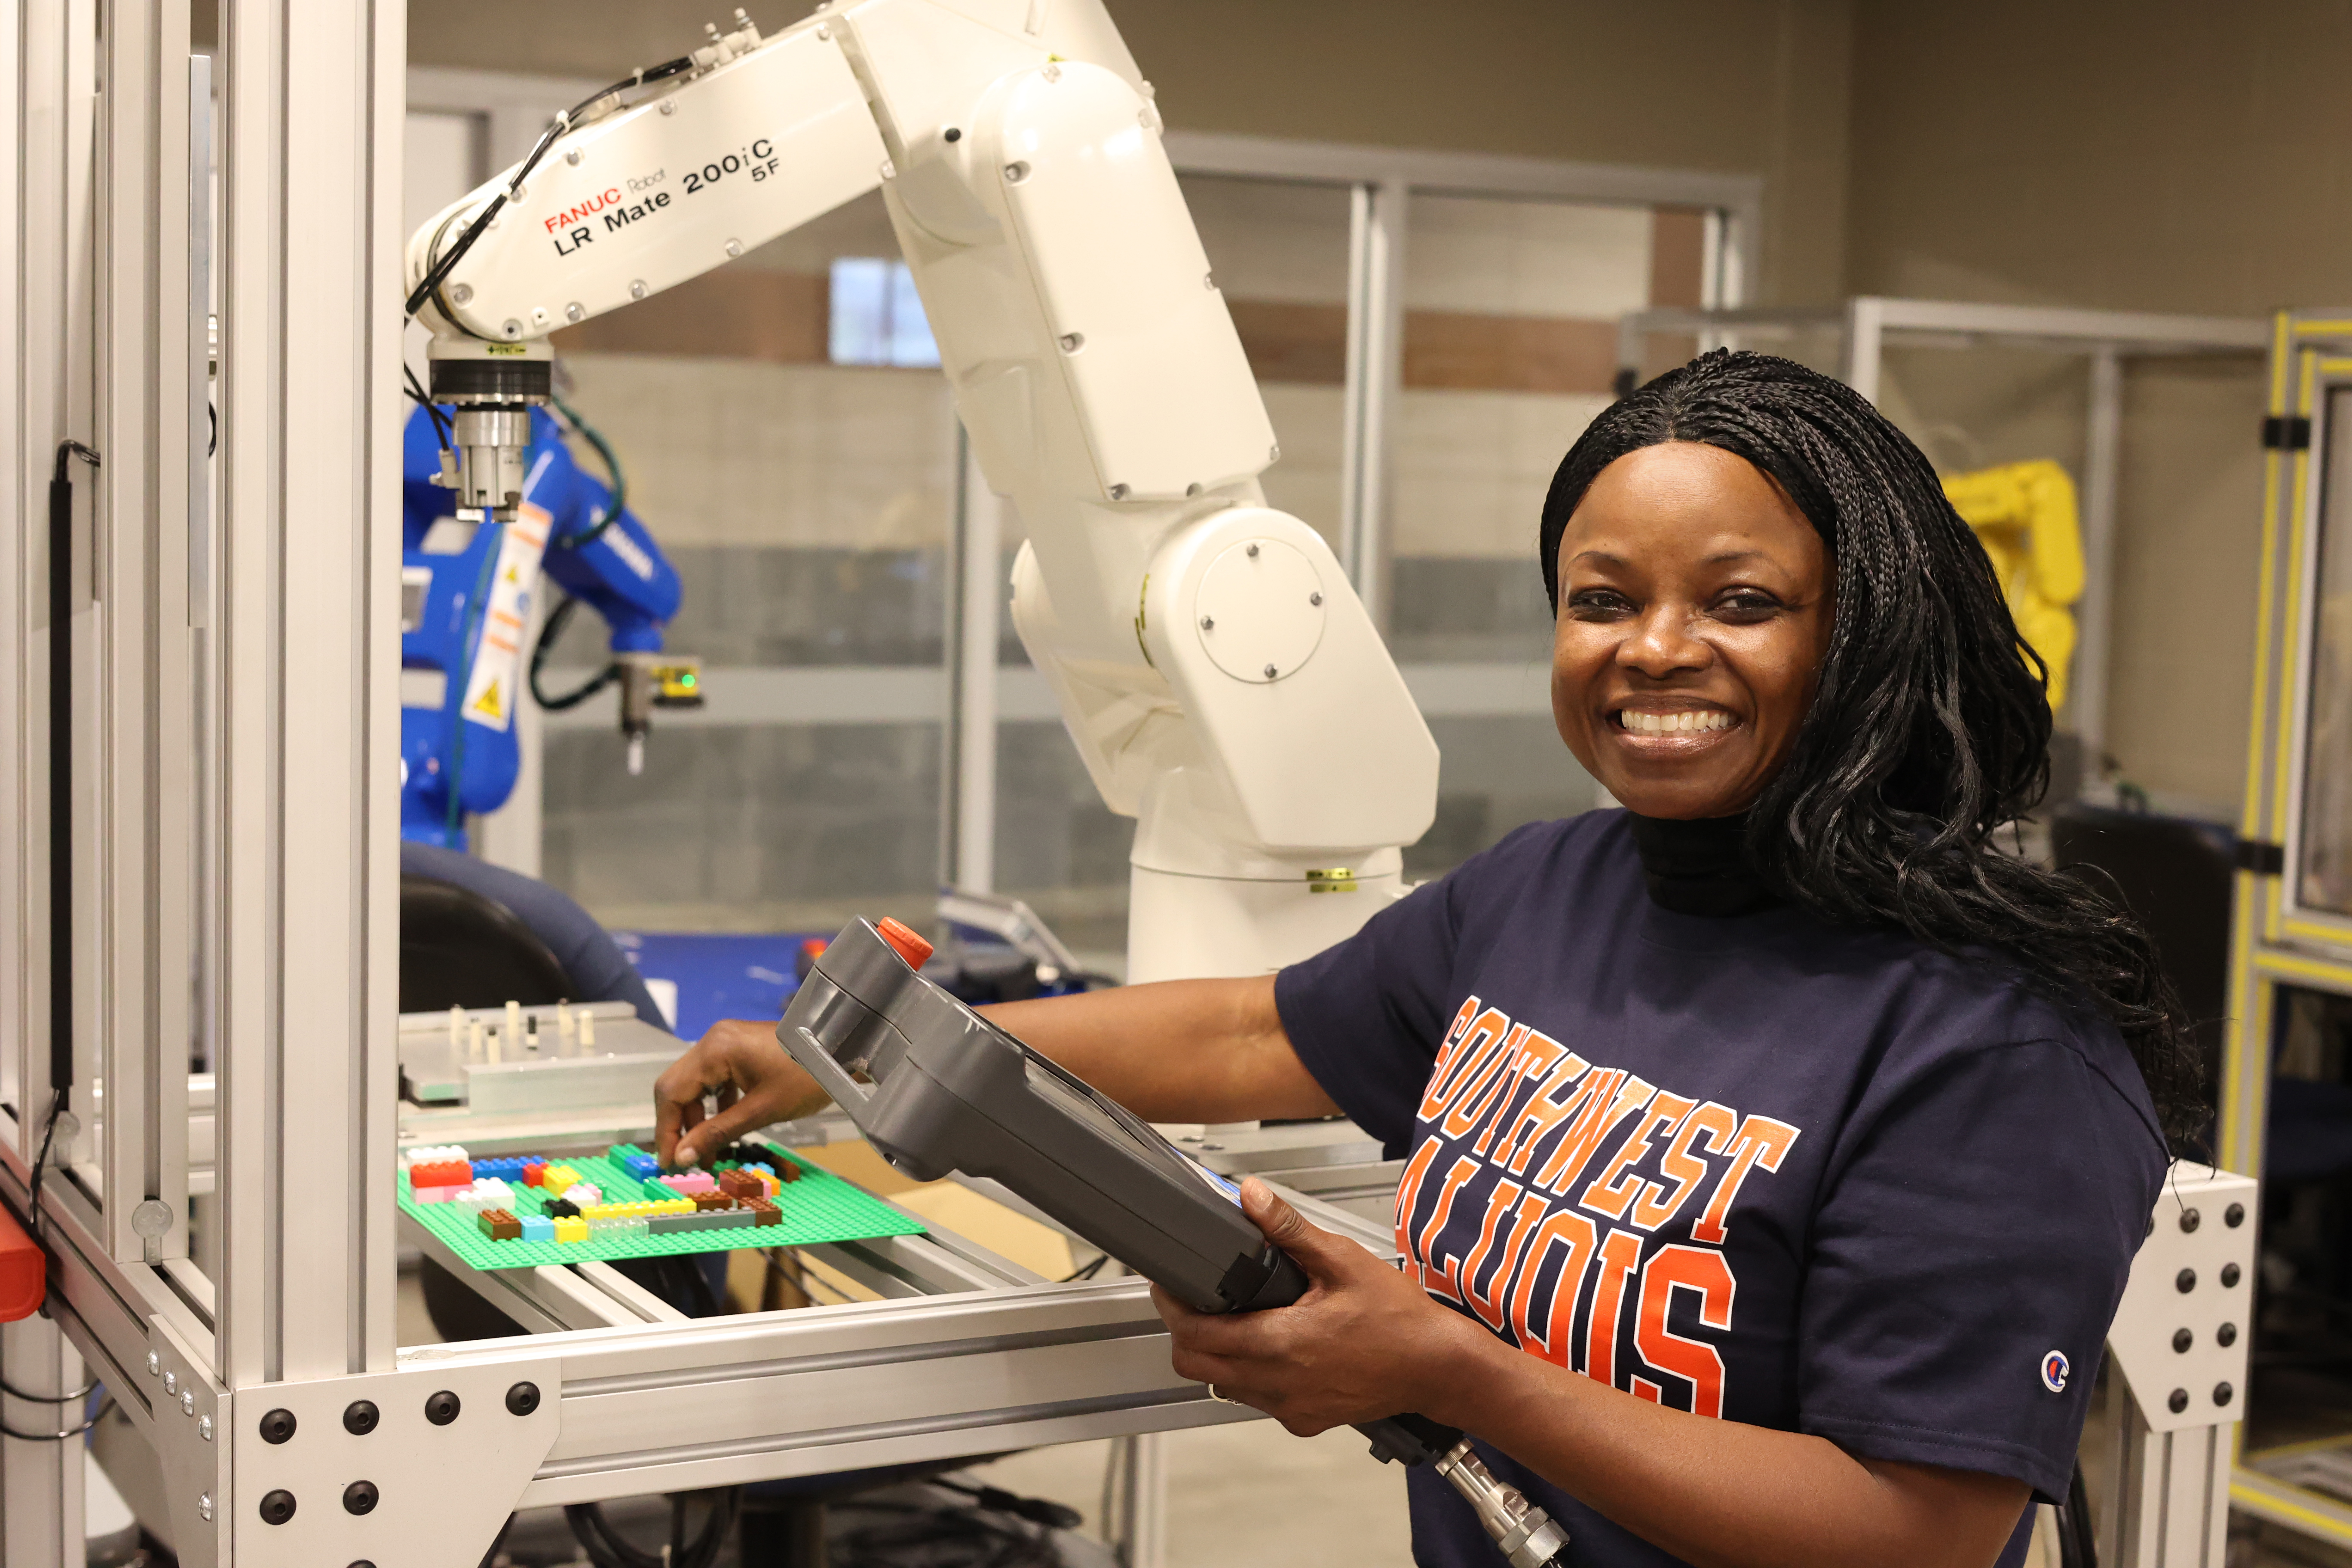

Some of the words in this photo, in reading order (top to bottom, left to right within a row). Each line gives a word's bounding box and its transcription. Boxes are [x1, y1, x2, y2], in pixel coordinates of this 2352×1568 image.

[544, 188, 622, 234] FANUC
[627, 168, 666, 194] Robot
[554, 226, 594, 257] LR
[603, 192, 671, 233] Mate
[682, 139, 773, 195] 200iC
[751, 159, 780, 182] 5F
[1417, 995, 1801, 1245] SOUTHWEST
